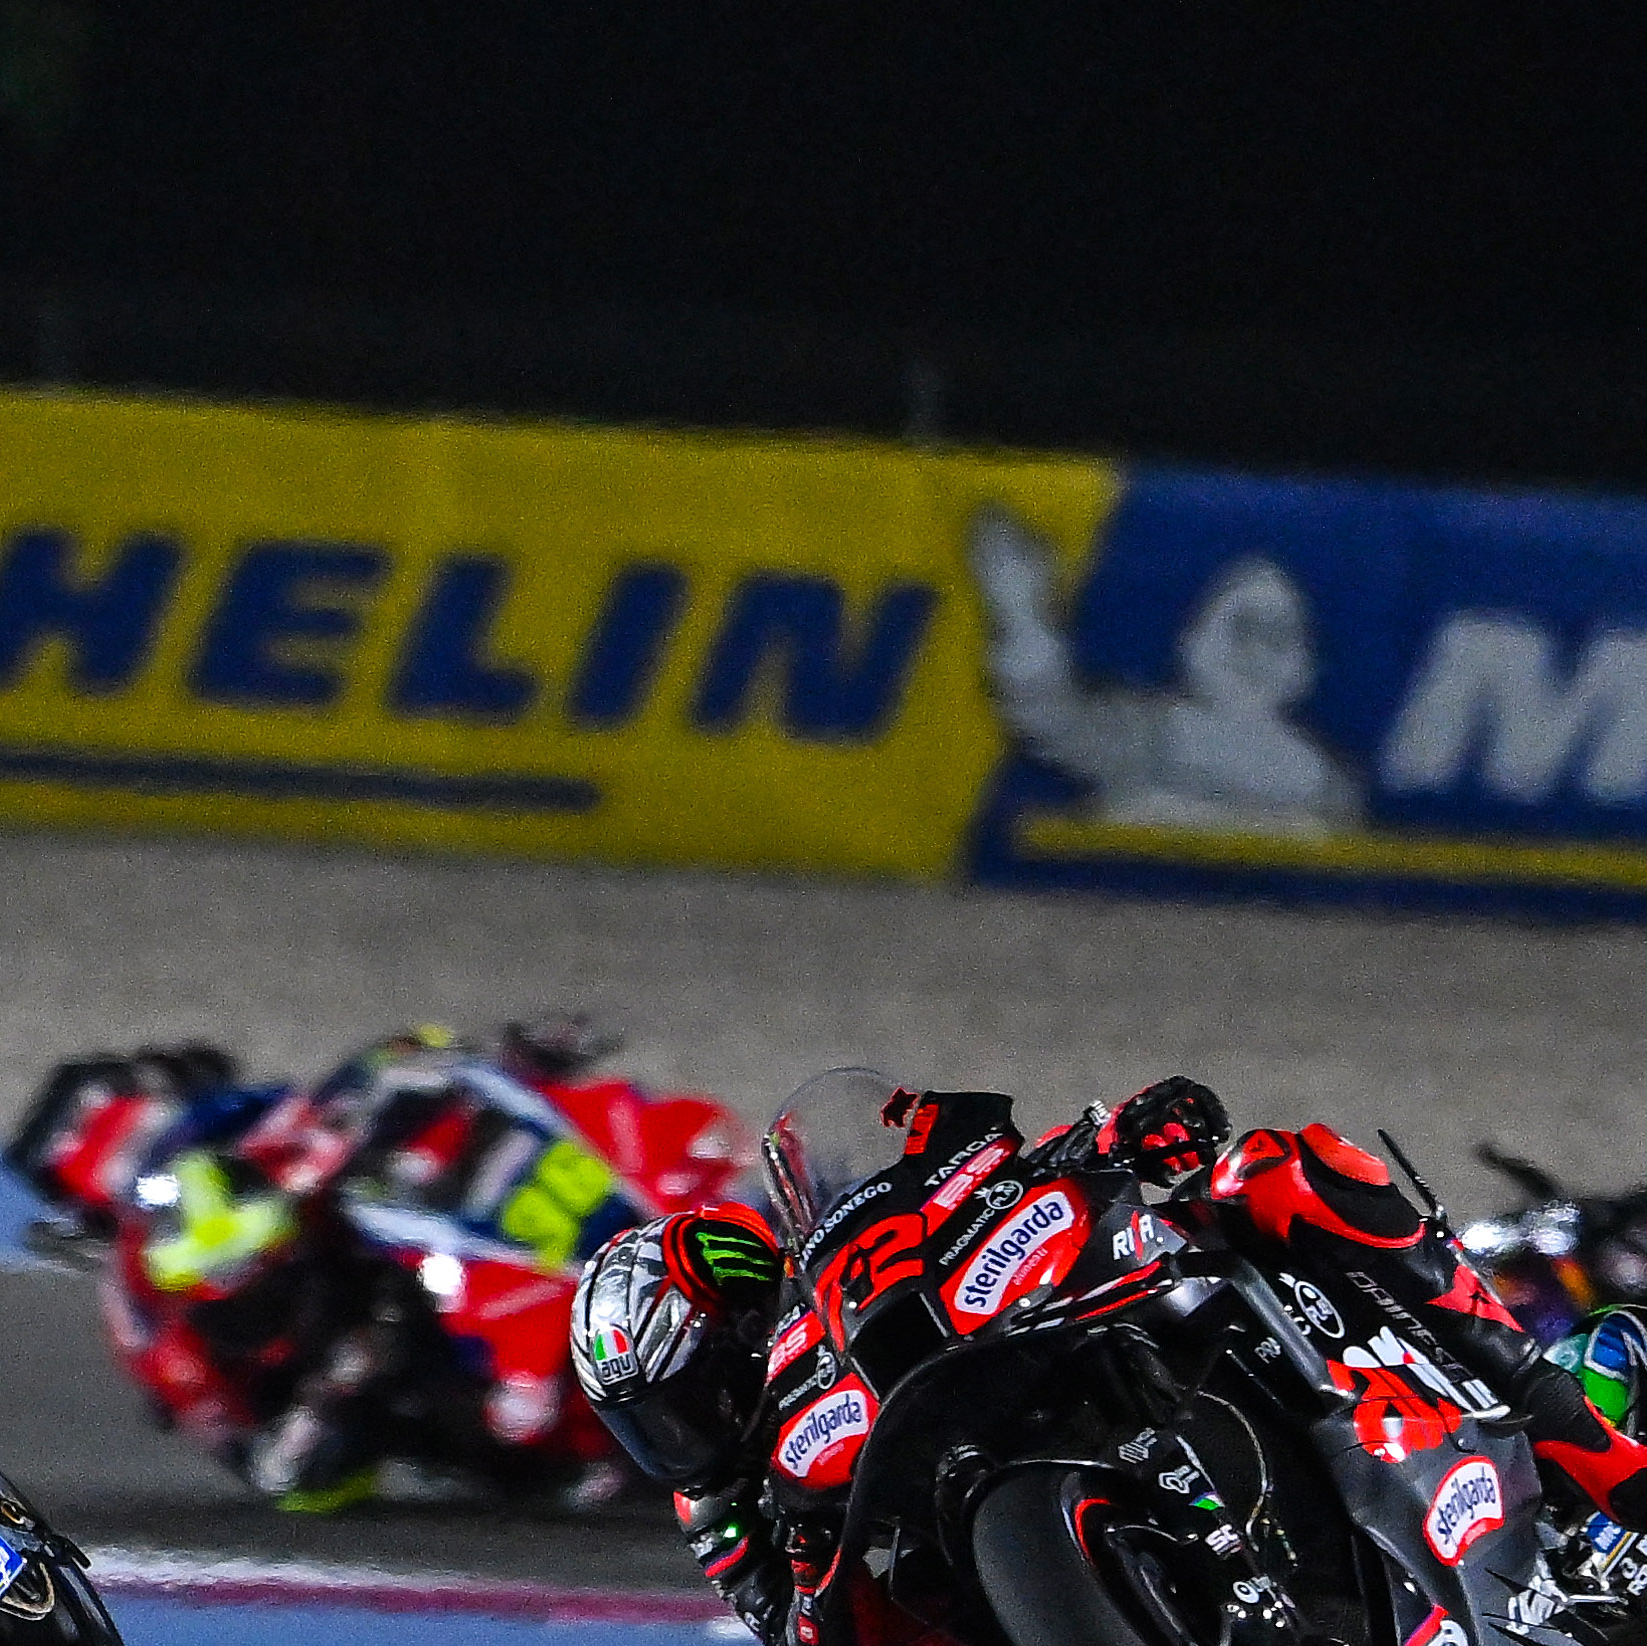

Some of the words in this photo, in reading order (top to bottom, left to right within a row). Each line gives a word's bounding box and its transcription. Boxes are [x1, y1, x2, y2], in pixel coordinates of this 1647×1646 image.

[823, 1181, 893, 1234] SONEGO
[939, 1206, 996, 1267] PRAGMATIC
[964, 1200, 1065, 1309] sterilgarda
[784, 1392, 862, 1470] sterilgarda
